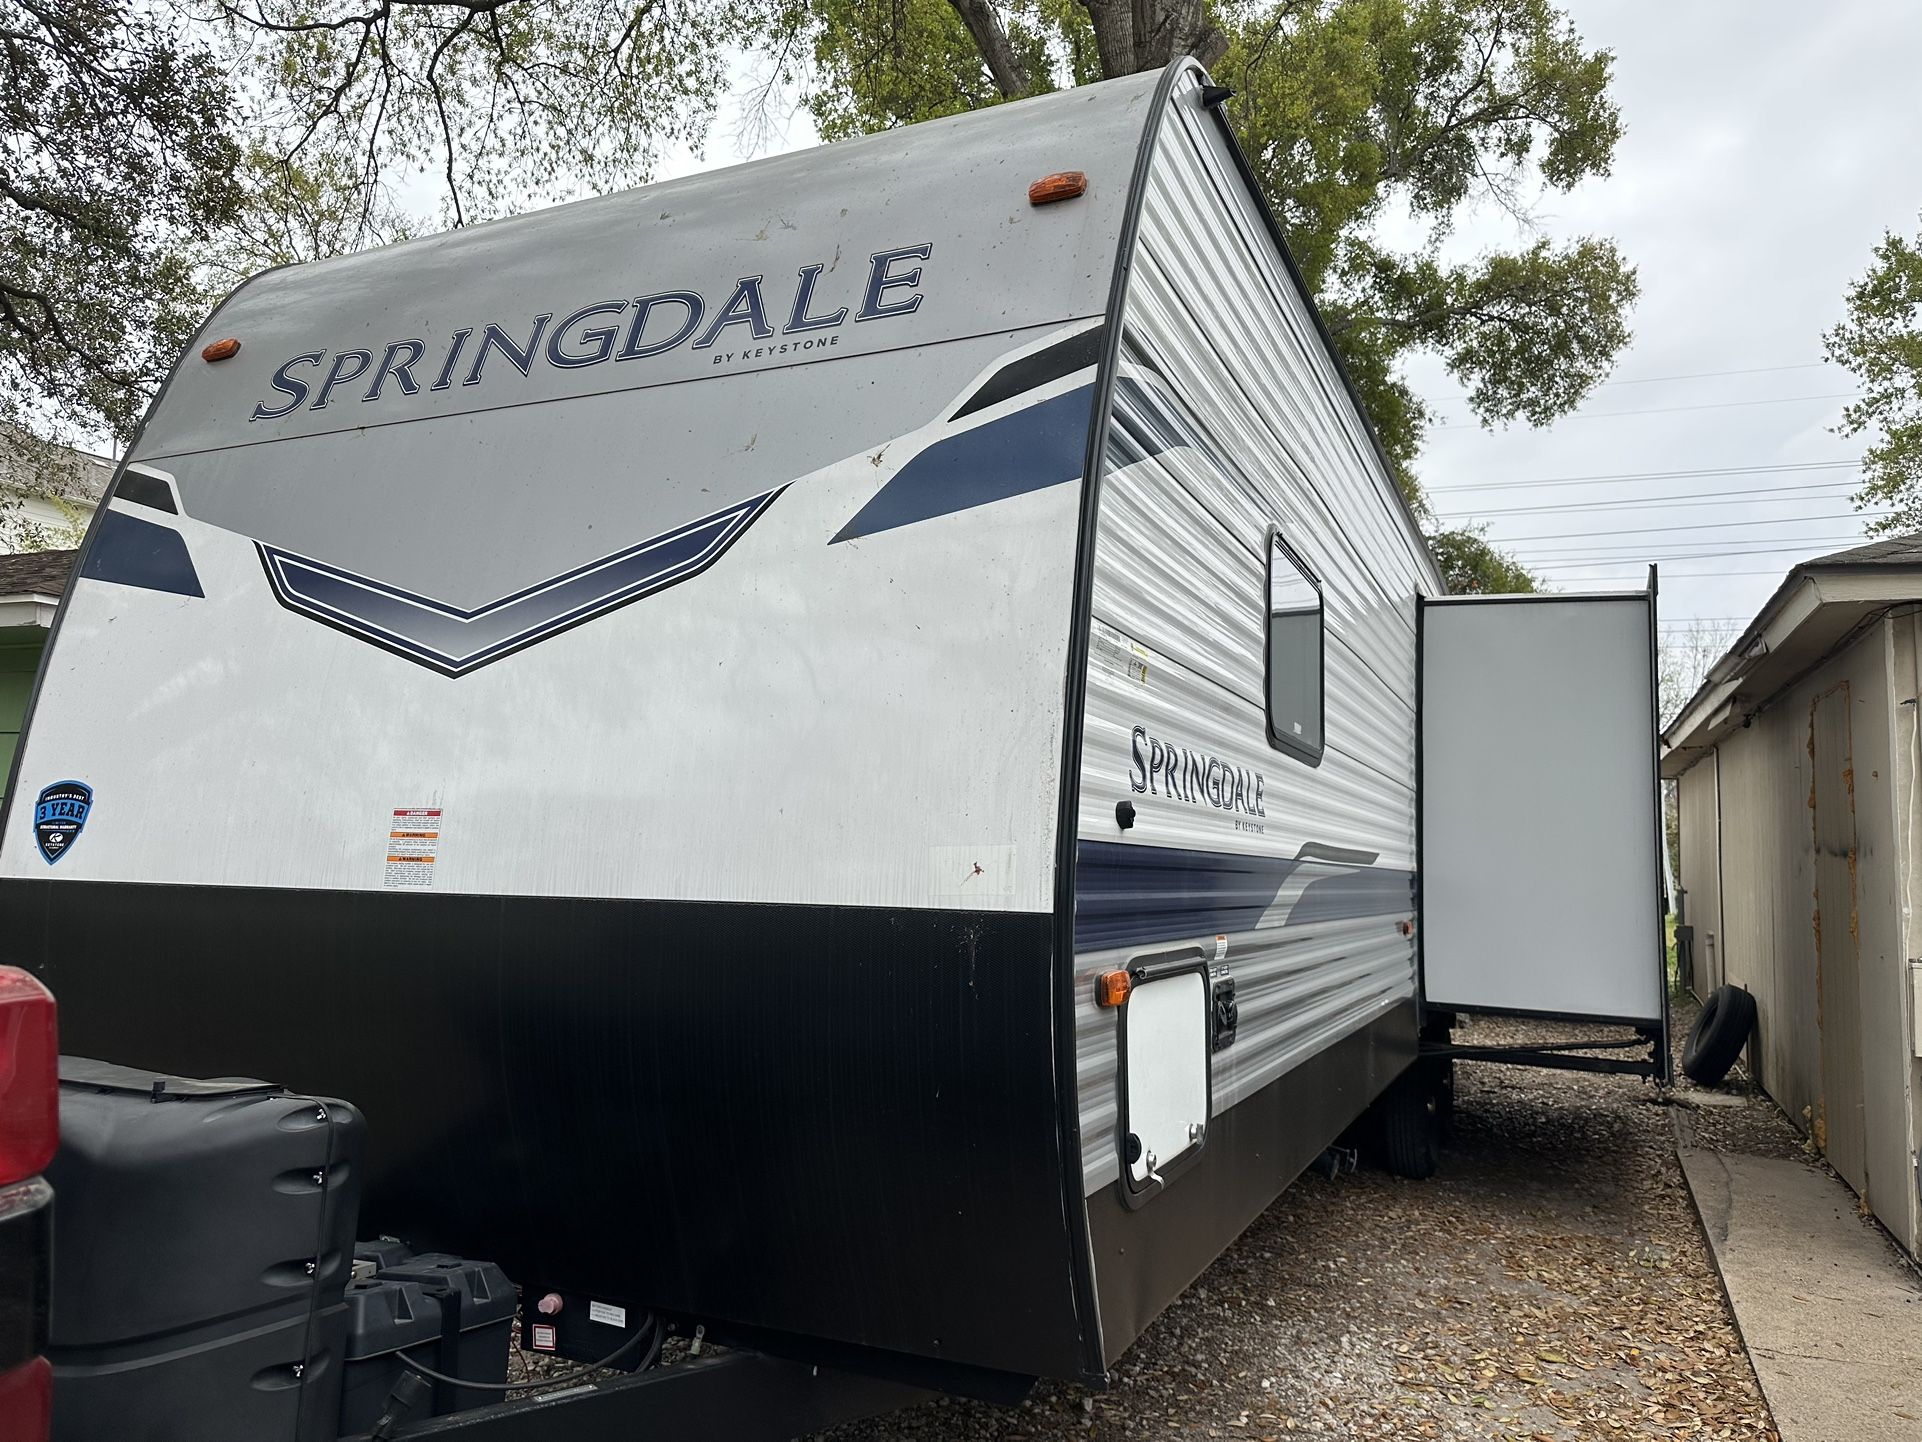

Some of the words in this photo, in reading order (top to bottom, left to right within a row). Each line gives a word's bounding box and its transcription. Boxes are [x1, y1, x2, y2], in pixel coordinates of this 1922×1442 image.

[249, 243, 934, 422] SPRINGDALE
[713, 353, 734, 364] BY
[742, 336, 839, 359] KEYSTONE
[1129, 725, 1265, 817] SPRINGDALE
[40, 806, 46, 819] 3
[51, 802, 85, 819] YEAR
[1235, 820, 1241, 830] BY
[1242, 824, 1264, 834] KEYSTONE
